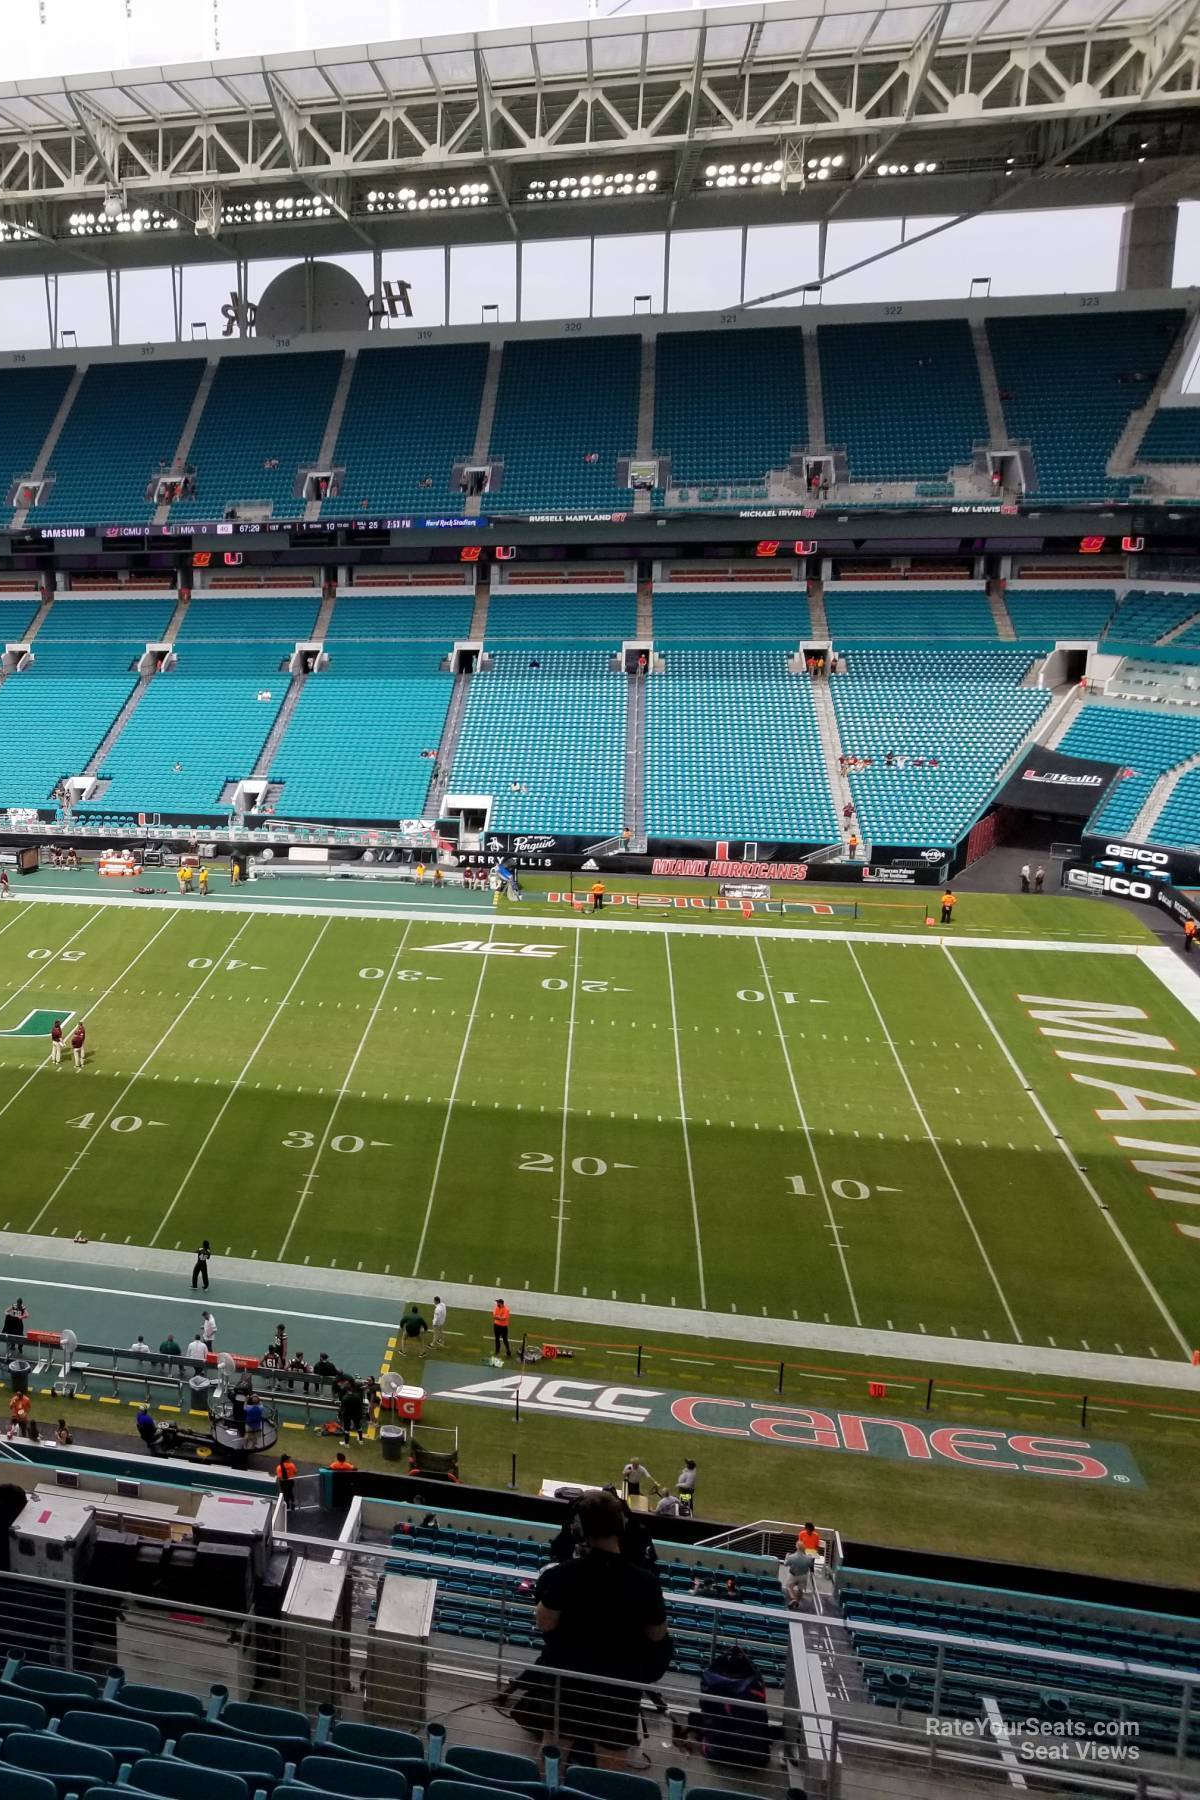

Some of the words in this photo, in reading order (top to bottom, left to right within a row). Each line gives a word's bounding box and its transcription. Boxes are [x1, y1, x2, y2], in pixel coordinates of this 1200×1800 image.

[1080, 297, 1099, 306] 323
[885, 306, 902, 315] 322
[720, 315, 736, 323] 321
[565, 323, 582, 331] 320
[417, 331, 432, 340] 319
[276, 339, 290, 347] 318
[13, 354, 26, 362] 316
[565, 514, 611, 522] MARYLAND
[739, 510, 777, 518] MICHAEL
[778, 509, 801, 517] IRVIN
[240, 524, 260, 533] 67:29
[368, 521, 378, 529] 25
[426, 519, 440, 527] Hard
[41, 528, 85, 538] SAMSUNG
[123, 528, 142, 536] CMU
[180, 526, 195, 534] MIA
[513, 836, 556, 853] Penguin
[459, 854, 504, 867] PERRY
[1105, 844, 1169, 865] GEICO
[651, 858, 708, 876] MIAMI
[709, 860, 808, 881] HURRICANES
[1068, 869, 1151, 899] GEICO
[26, 948, 88, 962] 50
[187, 957, 251, 972] 40
[358, 966, 424, 983] 30
[541, 978, 610, 994] 20
[736, 988, 799, 1004] 10
[64, 1111, 142, 1134] 40
[281, 1130, 365, 1153] 30
[516, 1152, 609, 1177] 20
[784, 1176, 871, 1201] 10
[266, 1358, 276, 1367] 61
[452, 1374, 665, 1423] ACC
[403, 1402, 416, 1414] G
